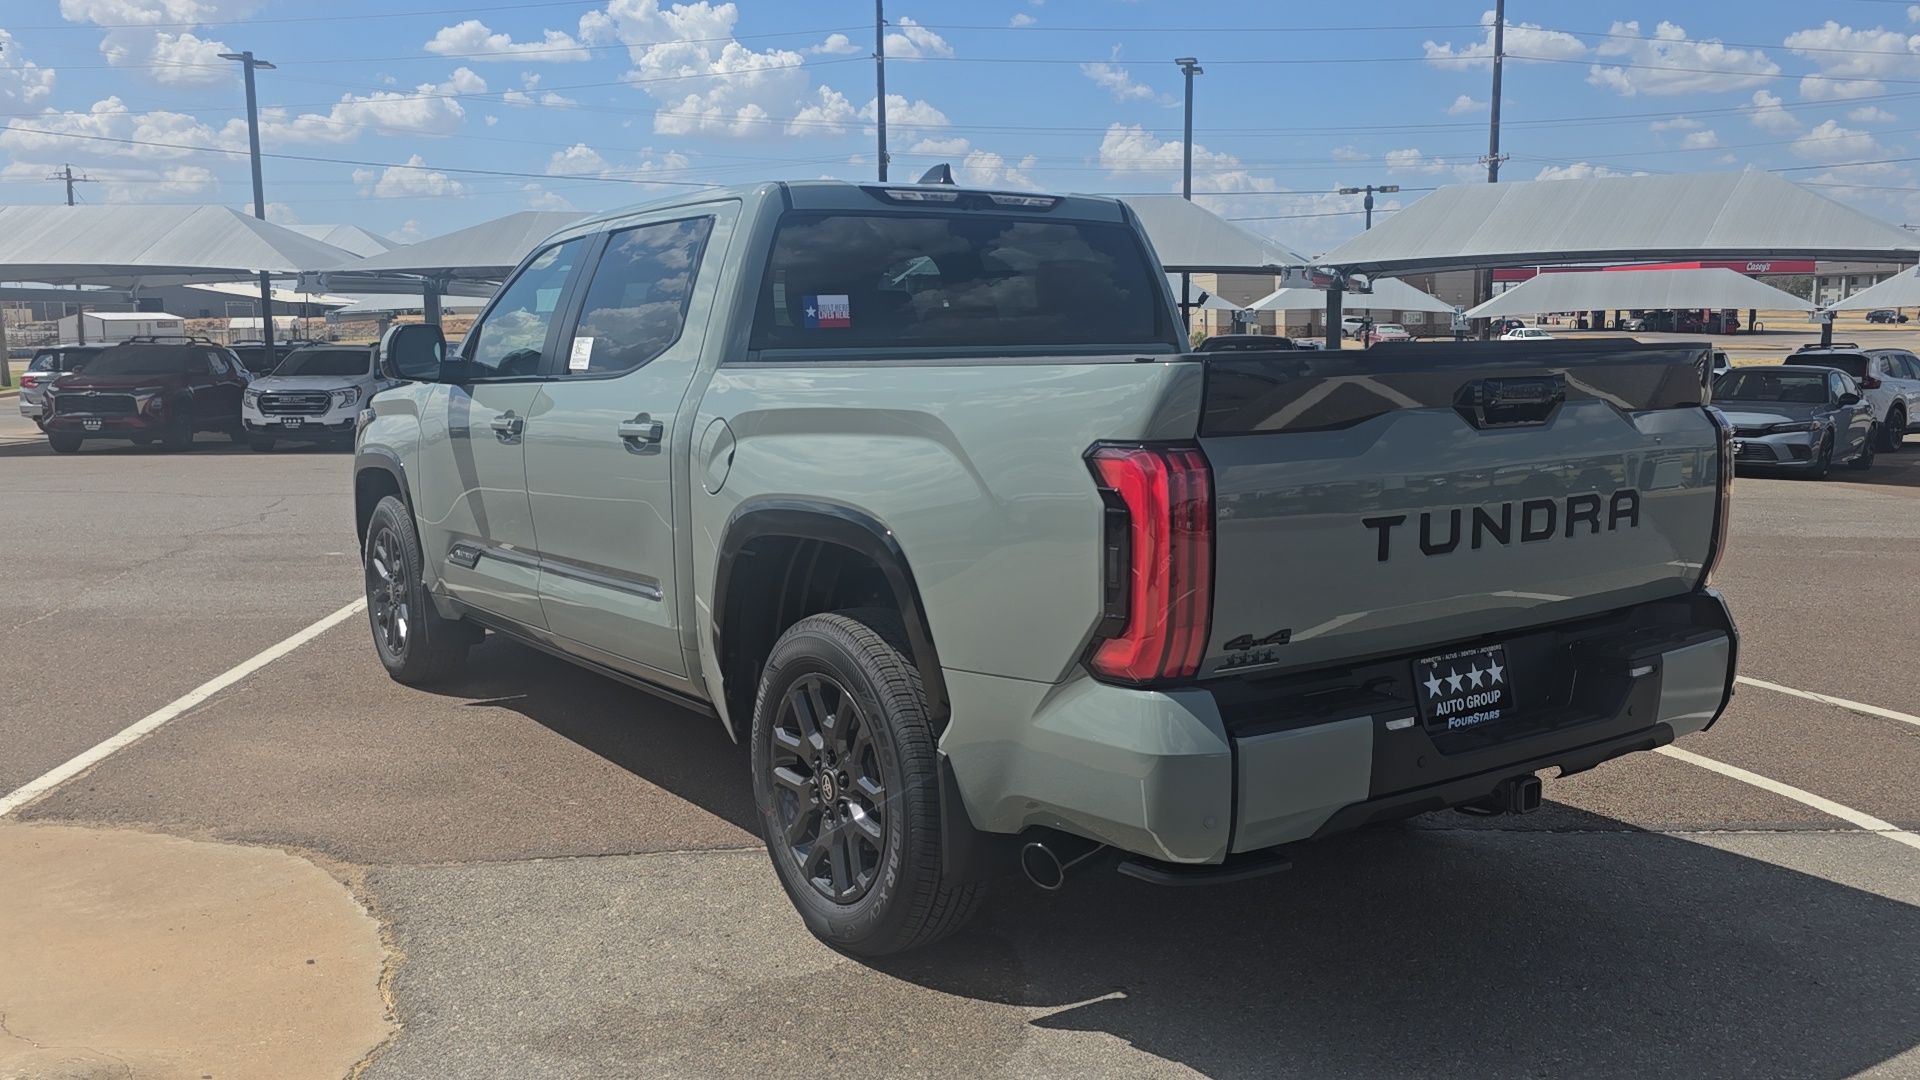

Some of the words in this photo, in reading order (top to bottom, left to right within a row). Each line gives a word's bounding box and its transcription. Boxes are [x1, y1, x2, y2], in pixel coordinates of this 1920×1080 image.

[1746, 262, 1771, 272] Casey's
[818, 303, 834, 311] BUILT
[835, 303, 850, 311] HERE
[818, 311, 835, 319] LIVES
[835, 310, 851, 319] HERE
[1361, 488, 1640, 562] TUNDRA
[1420, 655, 1442, 664] HENRIETTA
[1445, 652, 1457, 660] ALTUS
[1460, 649, 1476, 658] DENTON
[1479, 644, 1502, 654] JACKSBORO
[1436, 698, 1465, 716] AUTO
[1466, 689, 1502, 709] GROUP
[751, 676, 770, 760] YOKOHAMA
